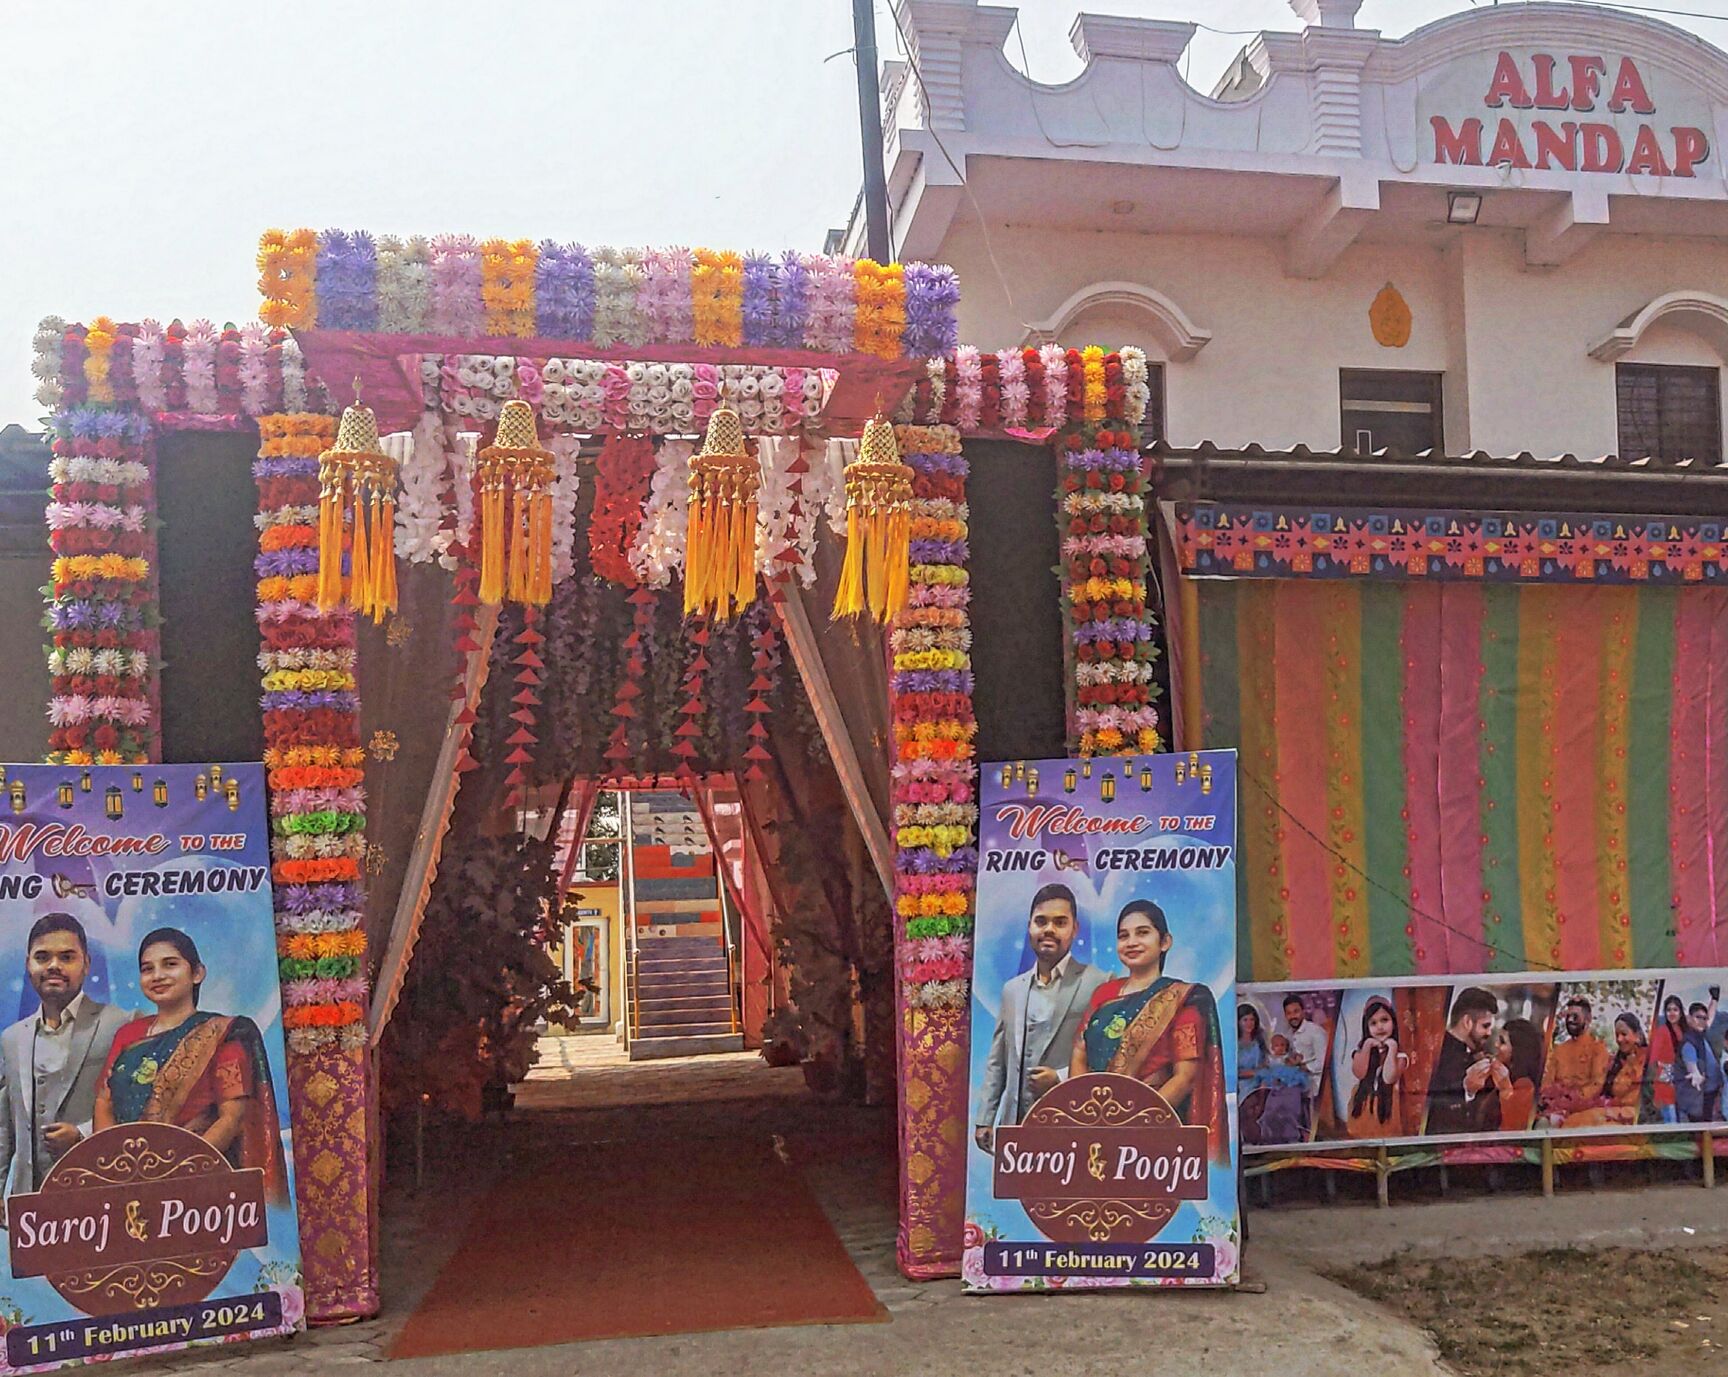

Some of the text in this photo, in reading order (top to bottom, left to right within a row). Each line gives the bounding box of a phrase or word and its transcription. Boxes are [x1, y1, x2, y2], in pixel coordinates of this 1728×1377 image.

[1484, 51, 1656, 114] ALFA
[1430, 115, 1709, 177] MANDAP
[0, 823, 245, 863] Welcome TO THE
[997, 805, 1214, 839] Welcome TO THE
[0, 867, 265, 899] NG CEREMONY
[986, 847, 1230, 873] RING CEREMONY
[1000, 1141, 1202, 1193] Saroj & Pooja
[17, 1191, 260, 1252] Saroj & Pooja
[999, 1249, 1200, 1273] 11th February 2024
[26, 1302, 265, 1355] 11th February 2024
